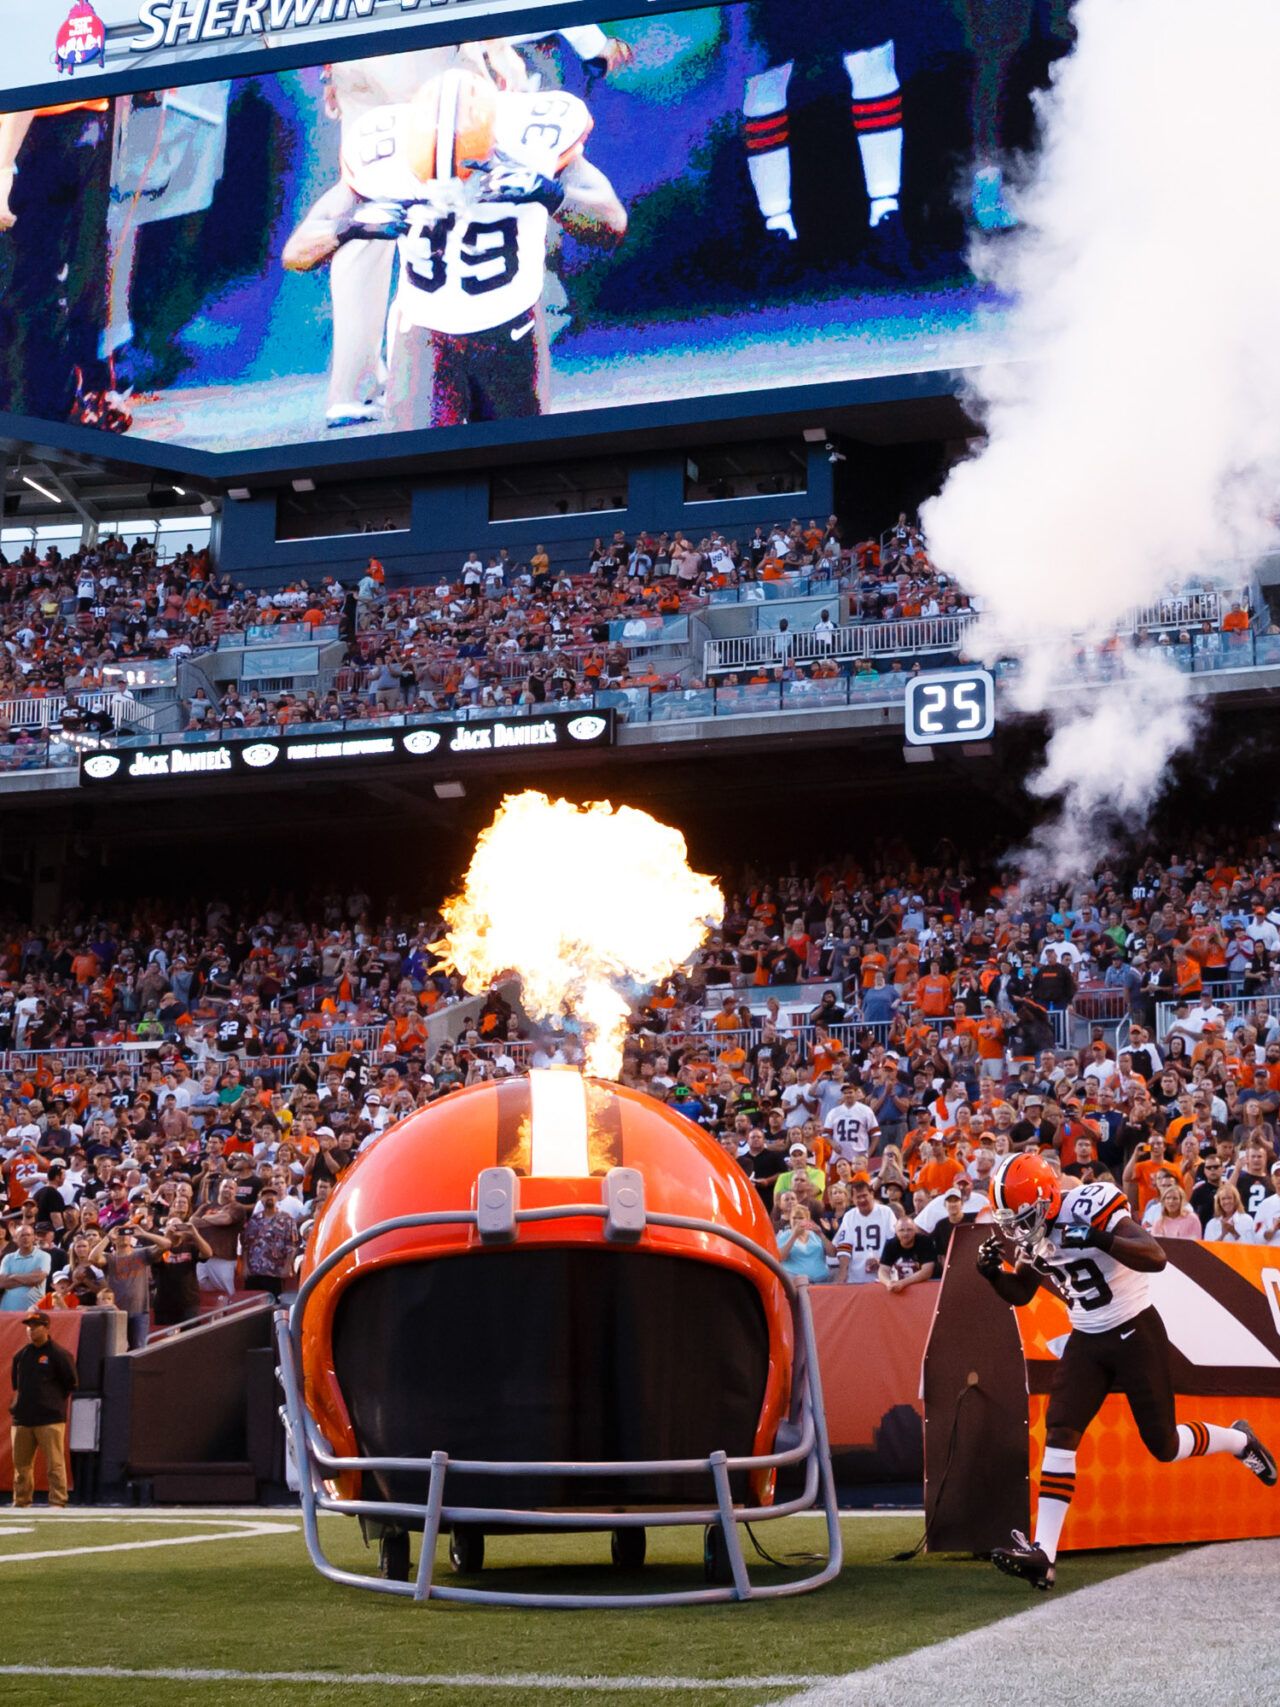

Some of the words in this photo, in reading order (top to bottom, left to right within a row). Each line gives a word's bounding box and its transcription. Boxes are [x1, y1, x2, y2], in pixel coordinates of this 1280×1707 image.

[919, 682, 980, 732] 25
[450, 727, 492, 751] JACK
[494, 720, 557, 748] DANIEL'S
[129, 752, 170, 776] JACK
[171, 747, 232, 773] DANIEL'S
[220, 1020, 240, 1036] 32
[836, 1119, 860, 1143] 42
[15, 1163, 39, 1181] 23
[1248, 1184, 1265, 1213] 2
[854, 1223, 880, 1252] 19
